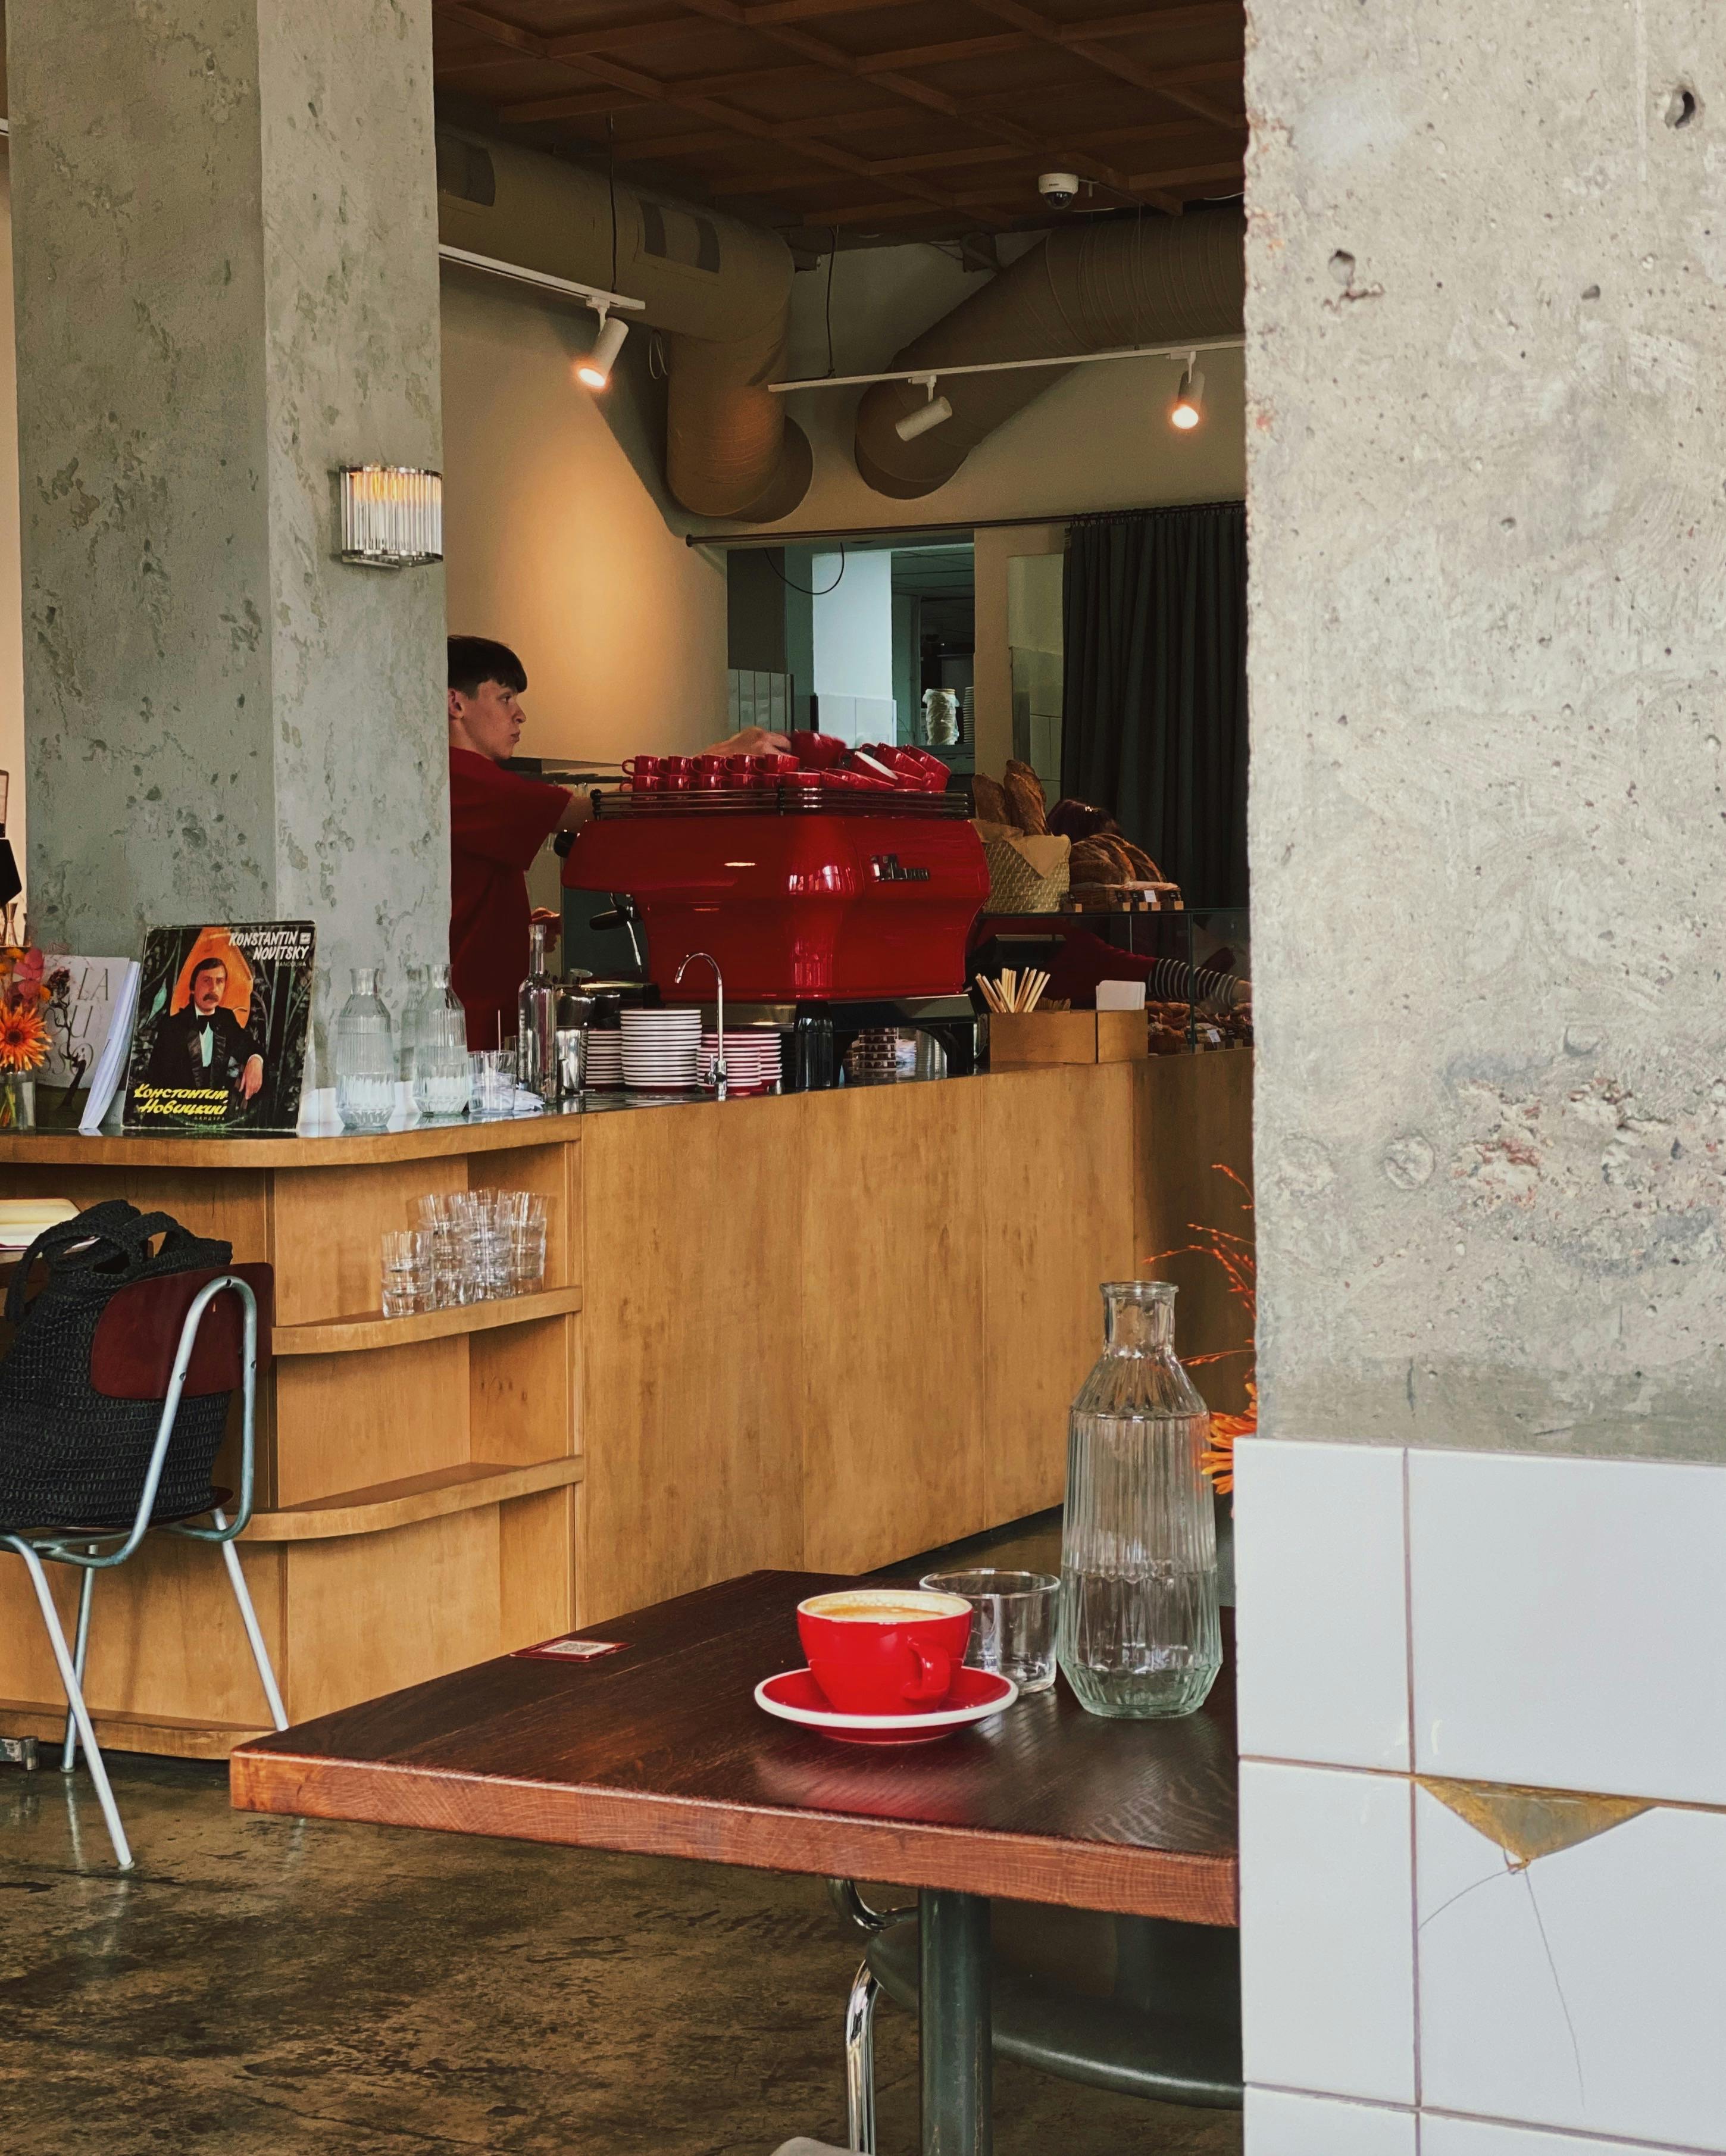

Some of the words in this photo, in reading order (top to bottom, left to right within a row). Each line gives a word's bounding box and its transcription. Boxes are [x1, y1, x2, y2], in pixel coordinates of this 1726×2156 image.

[229, 931, 298, 948] KONSTANTIN
[253, 945, 309, 960] NOVITSKY
[77, 968, 109, 1001] LA
[133, 1083, 229, 1100] Константин
[139, 1098, 229, 1116] Новицкий
